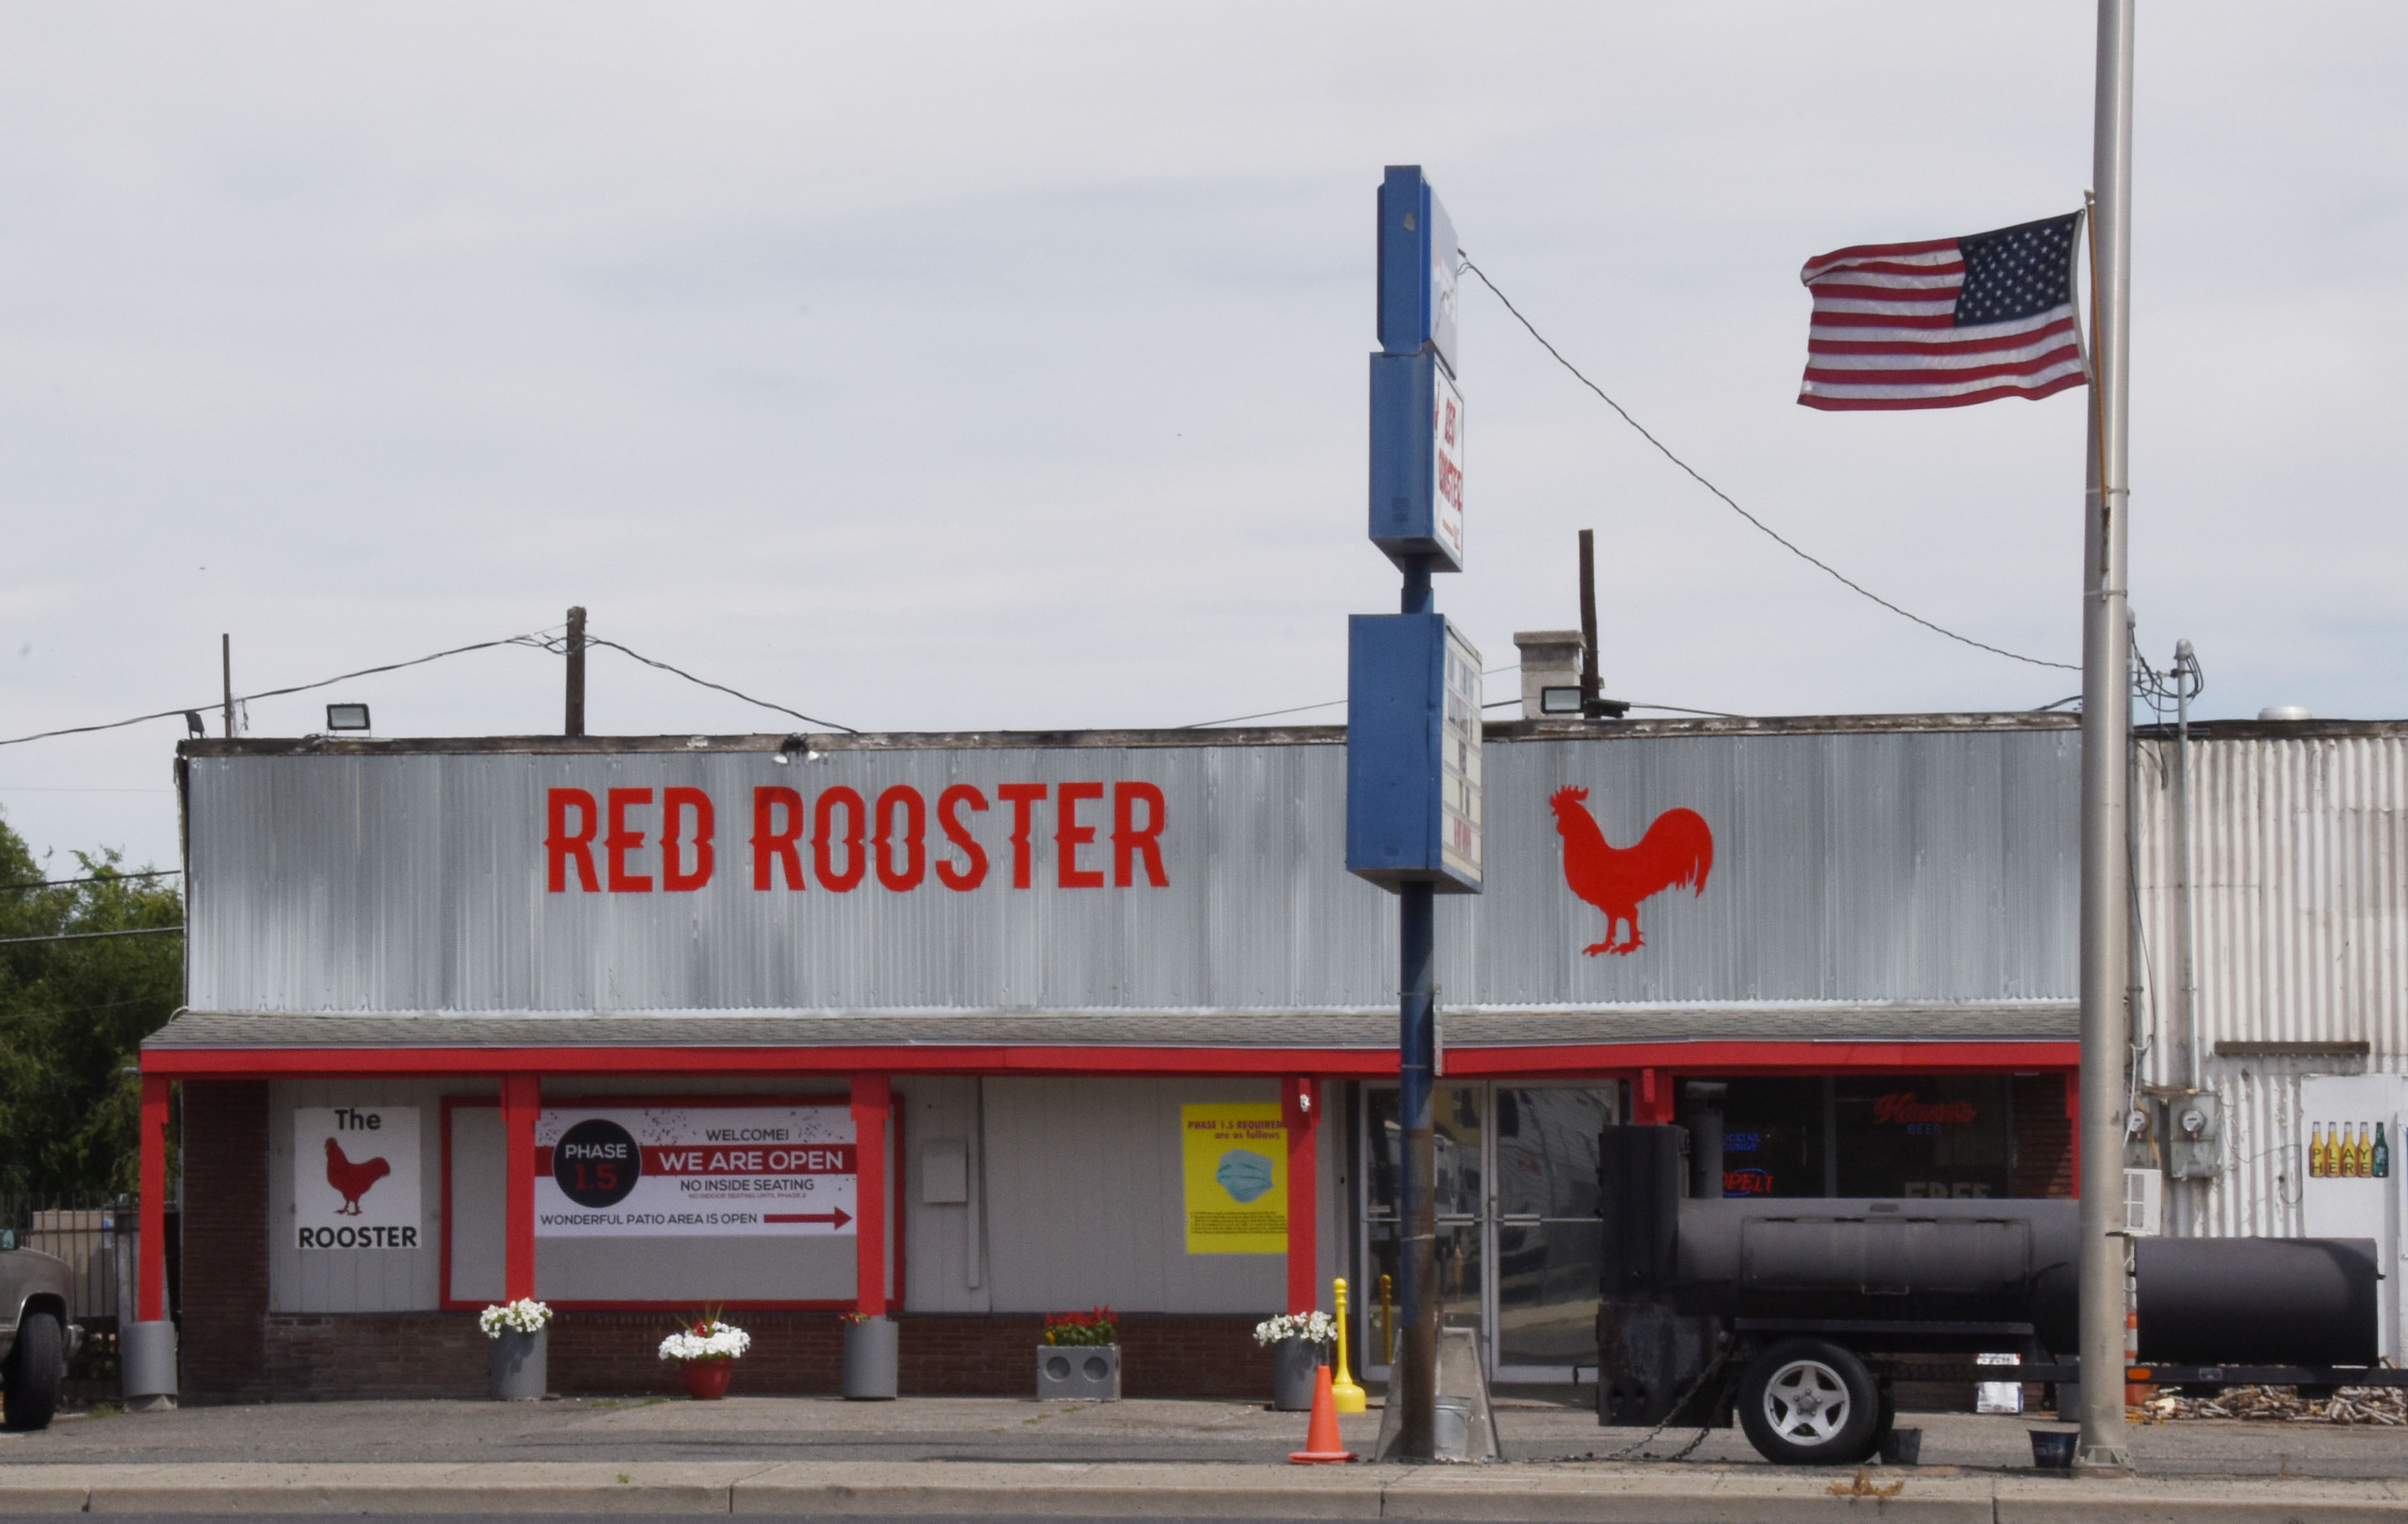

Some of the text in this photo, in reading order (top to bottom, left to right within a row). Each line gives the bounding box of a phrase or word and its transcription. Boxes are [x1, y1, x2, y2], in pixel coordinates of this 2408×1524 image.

[543, 781, 1169, 893] RED ROOSTER
[334, 1108, 381, 1131] The
[1188, 1120, 1216, 1129] PHASE
[1908, 1123, 1941, 1135] BEER
[565, 1143, 628, 1159] PHASE
[2313, 1148, 2369, 1160] PLAY
[658, 1150, 843, 1171] WE ARE OPEN
[2313, 1162, 2370, 1174] HERE
[574, 1163, 618, 1191] 1.5
[680, 1179, 814, 1191] NO INSIDE SEATING
[540, 1212, 758, 1225] WONDERFUL PATIO AREA IS OPEN
[299, 1226, 417, 1248] ROOSTER
